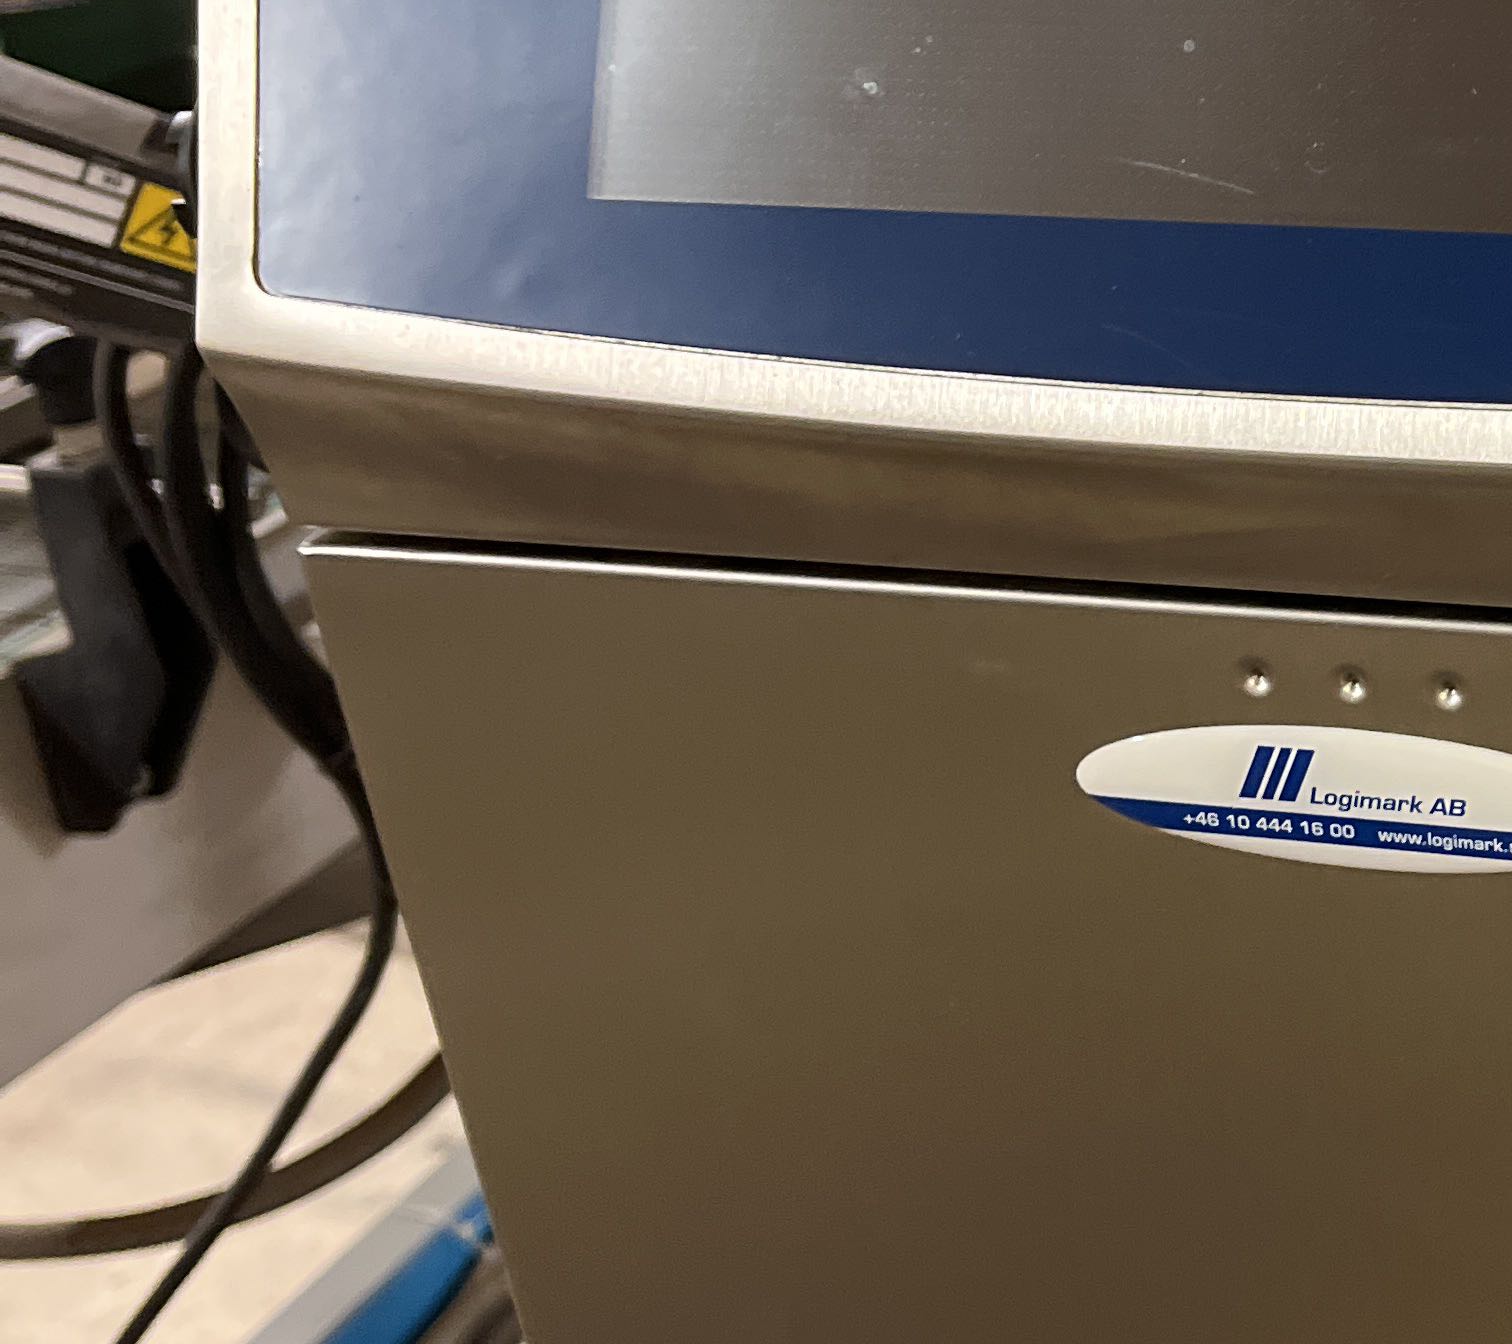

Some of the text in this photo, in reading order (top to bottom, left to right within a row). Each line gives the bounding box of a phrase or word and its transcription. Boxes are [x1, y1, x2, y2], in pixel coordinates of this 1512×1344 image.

[1309, 786, 1468, 818] Logimark AB
[1182, 810, 1221, 828] +46
[1225, 813, 1251, 830] 10
[1255, 816, 1294, 834] 444
[1299, 819, 1325, 838] 16
[1329, 822, 1356, 840] 00
